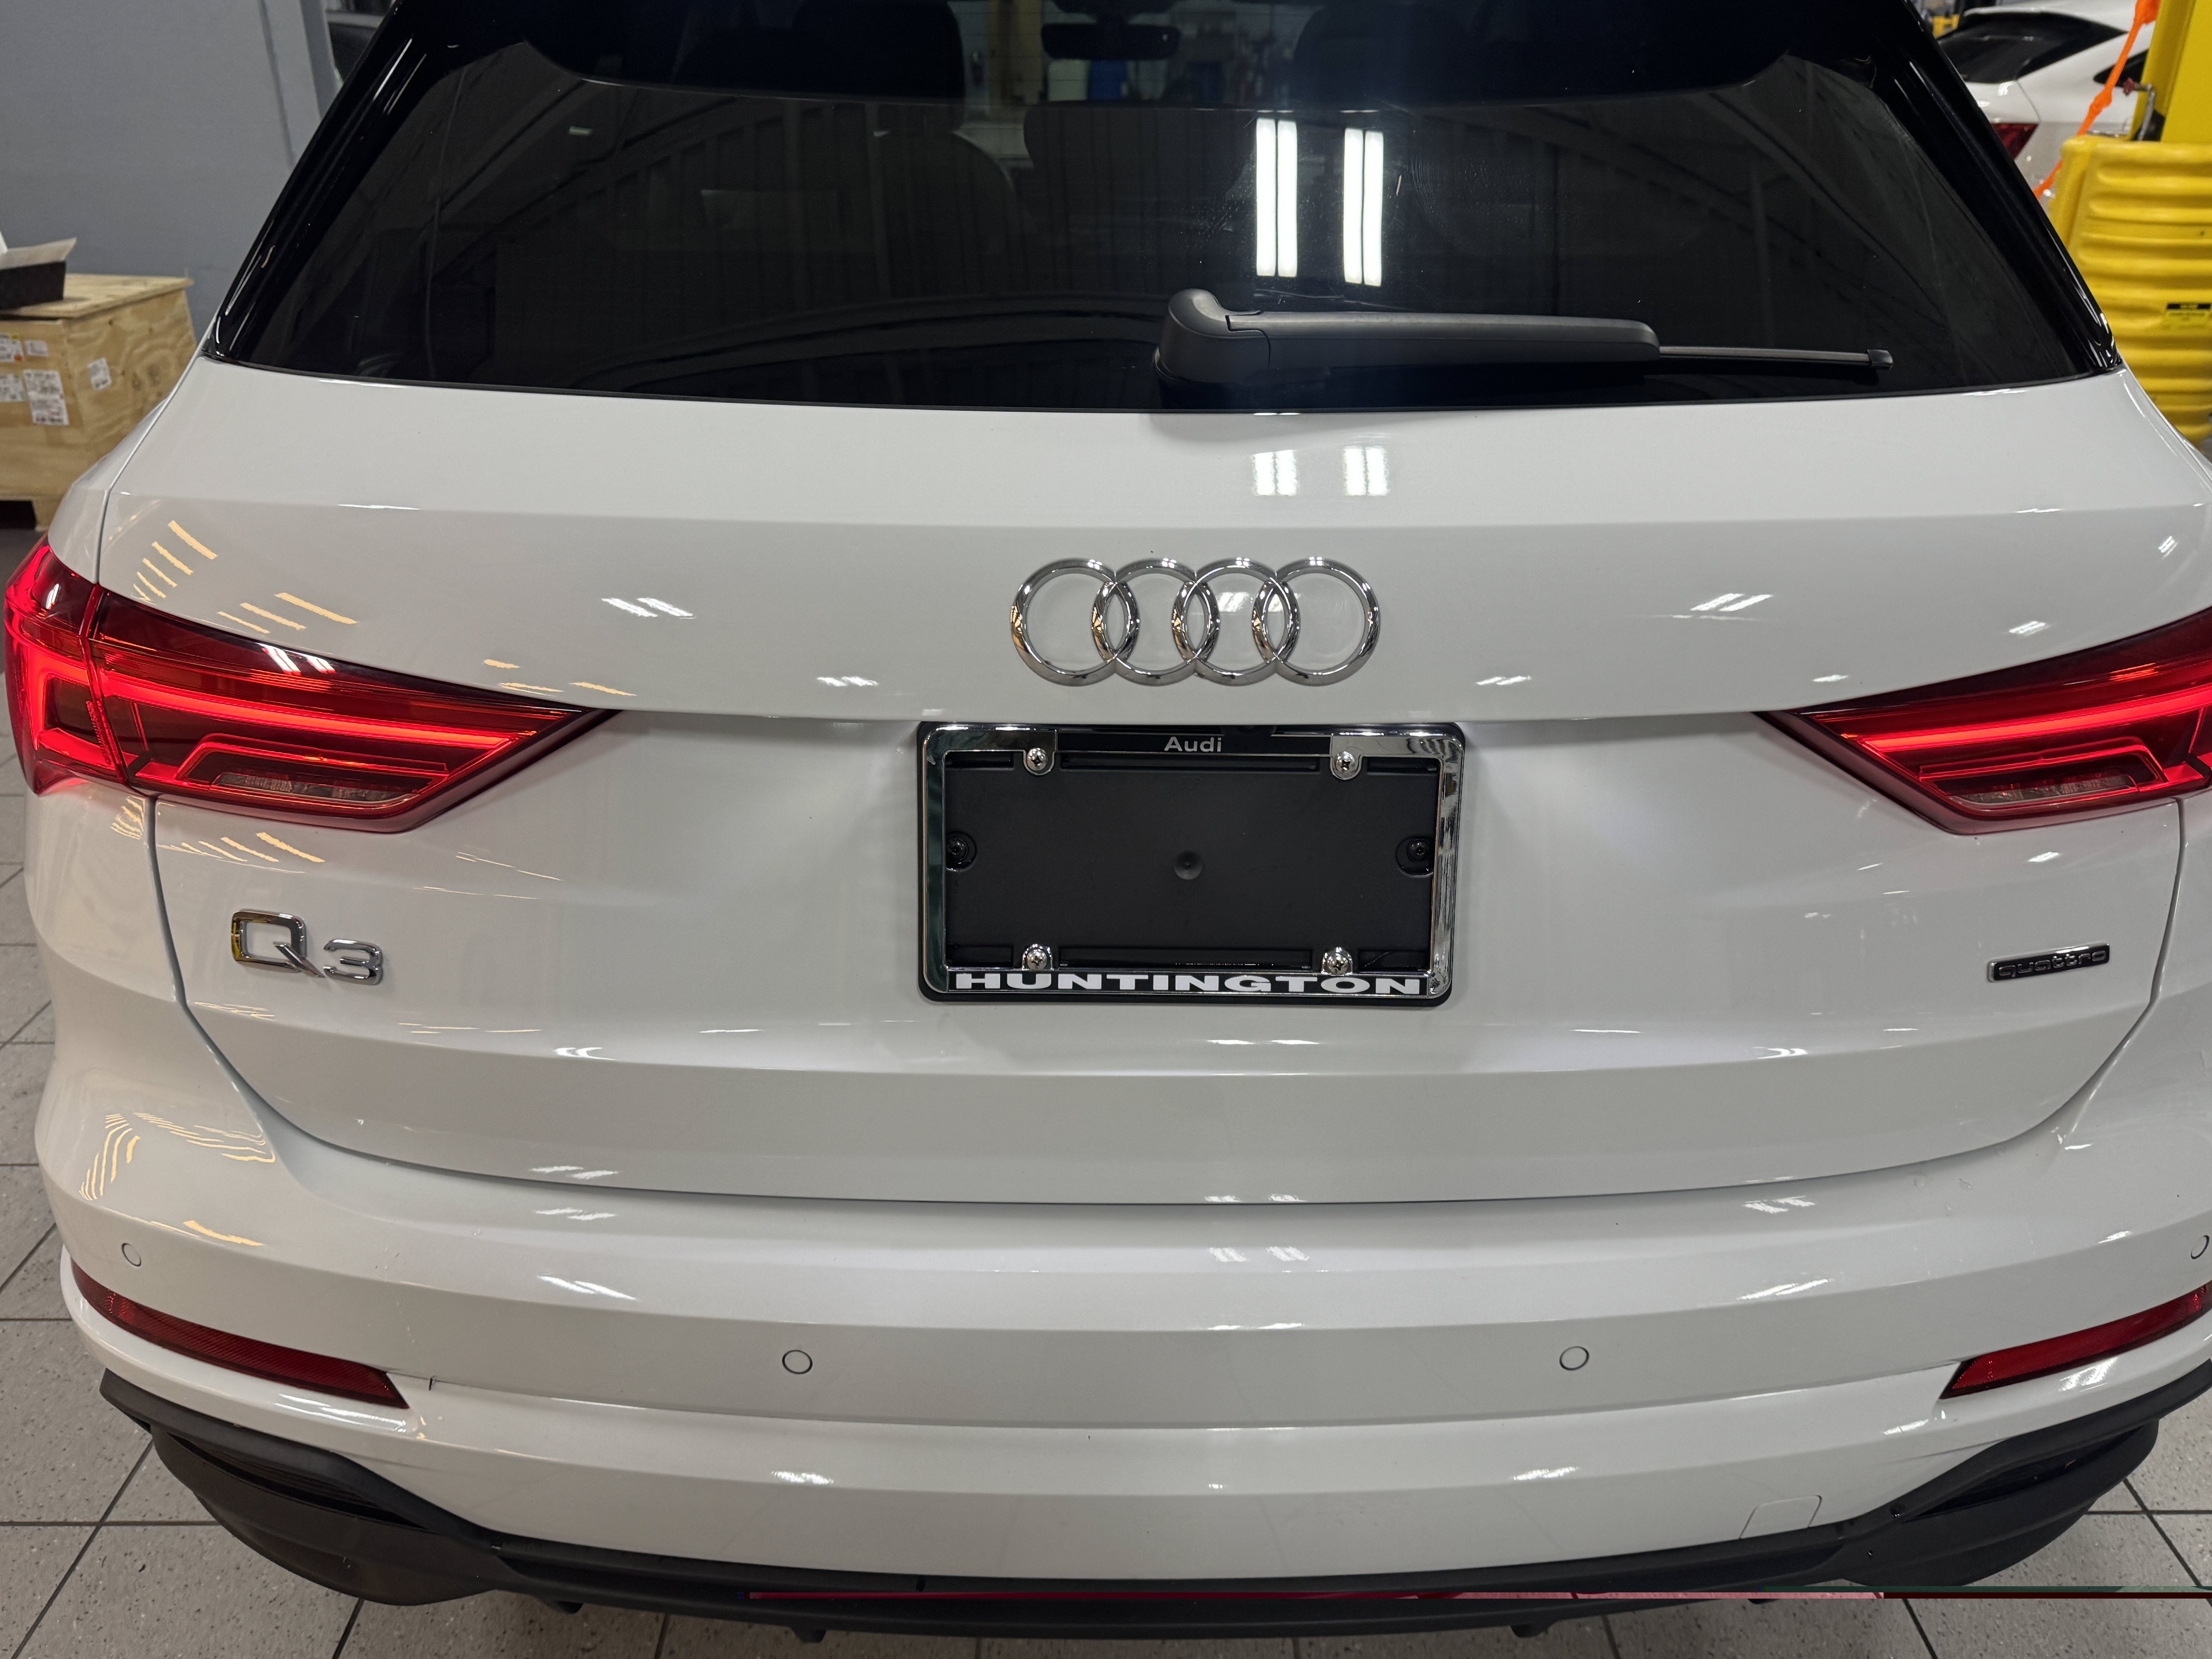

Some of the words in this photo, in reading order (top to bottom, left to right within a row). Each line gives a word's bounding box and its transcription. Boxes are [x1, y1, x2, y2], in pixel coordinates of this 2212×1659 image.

[1164, 736, 1221, 752] Audi
[231, 908, 383, 986] Q3
[1999, 950, 2106, 977] quattro
[956, 973, 1420, 994] HUNTINGTON
